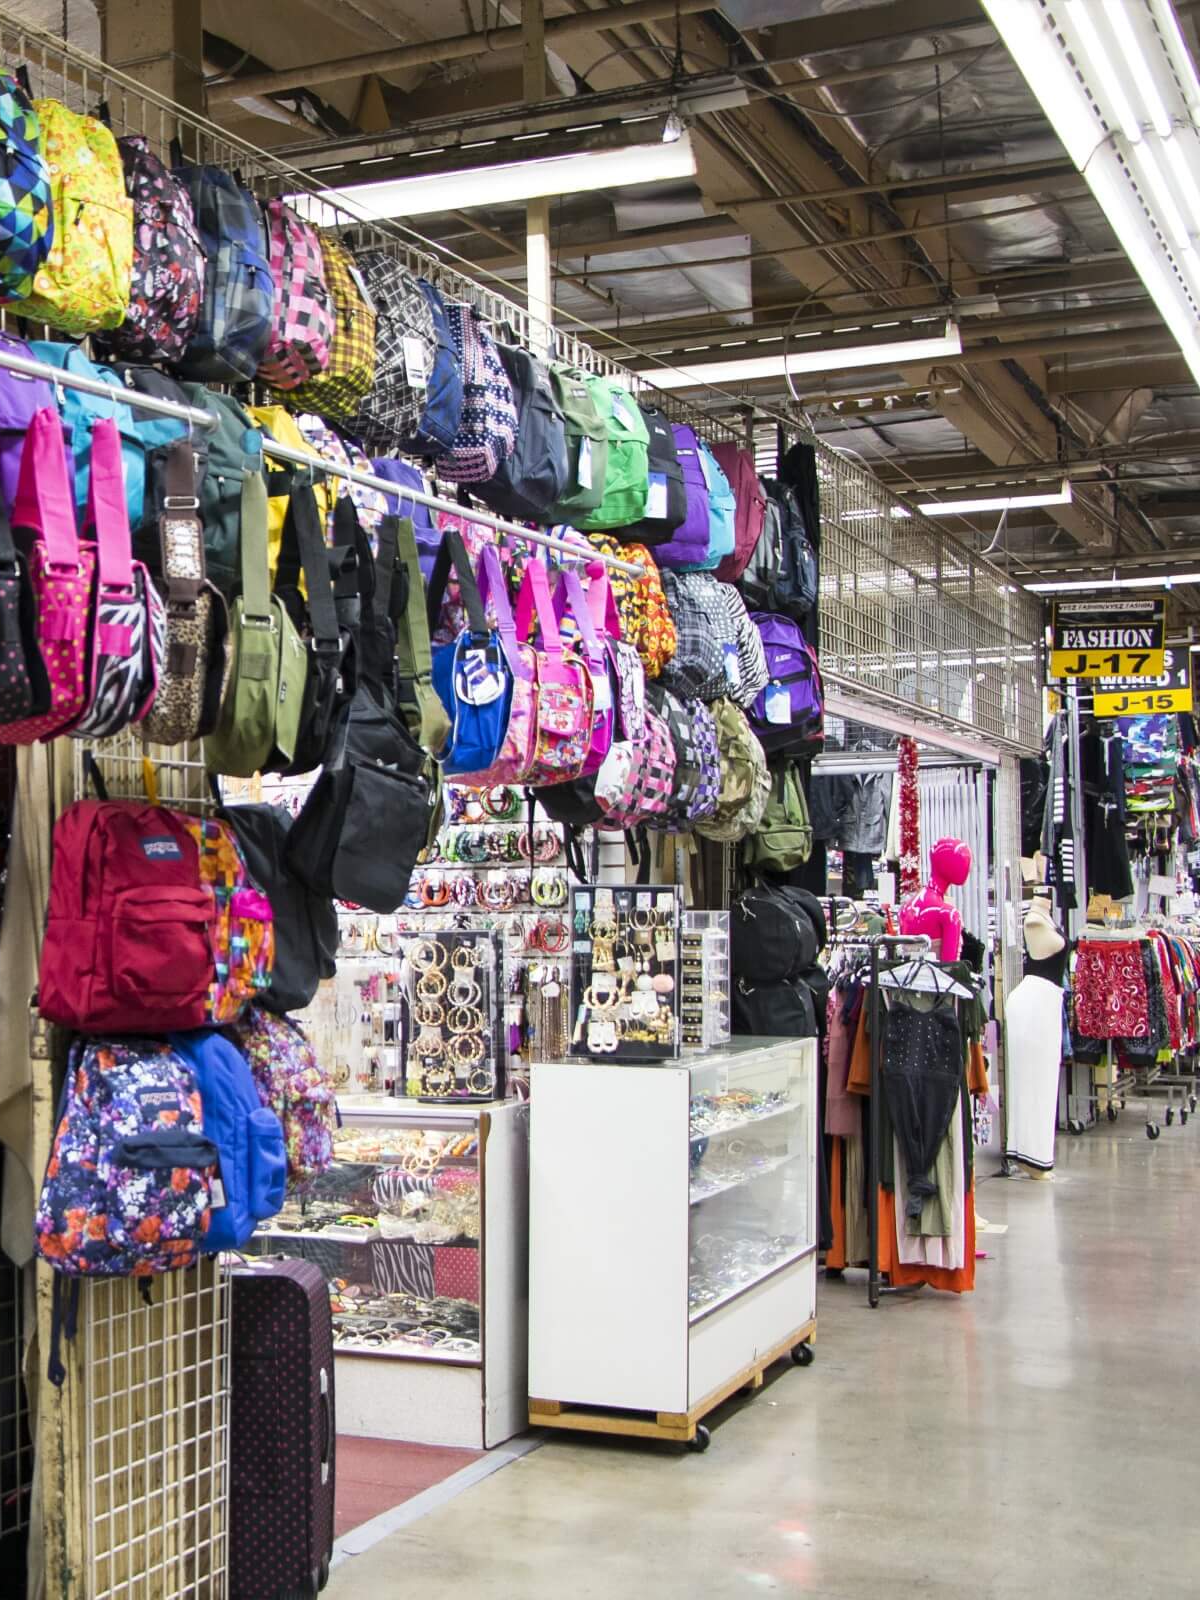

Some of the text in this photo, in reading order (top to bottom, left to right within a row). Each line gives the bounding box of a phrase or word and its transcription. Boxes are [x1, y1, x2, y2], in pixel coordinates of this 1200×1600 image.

[1062, 628, 1154, 649] FASHION
[1064, 653, 1151, 674] J-17
[1113, 694, 1174, 712] J-15
